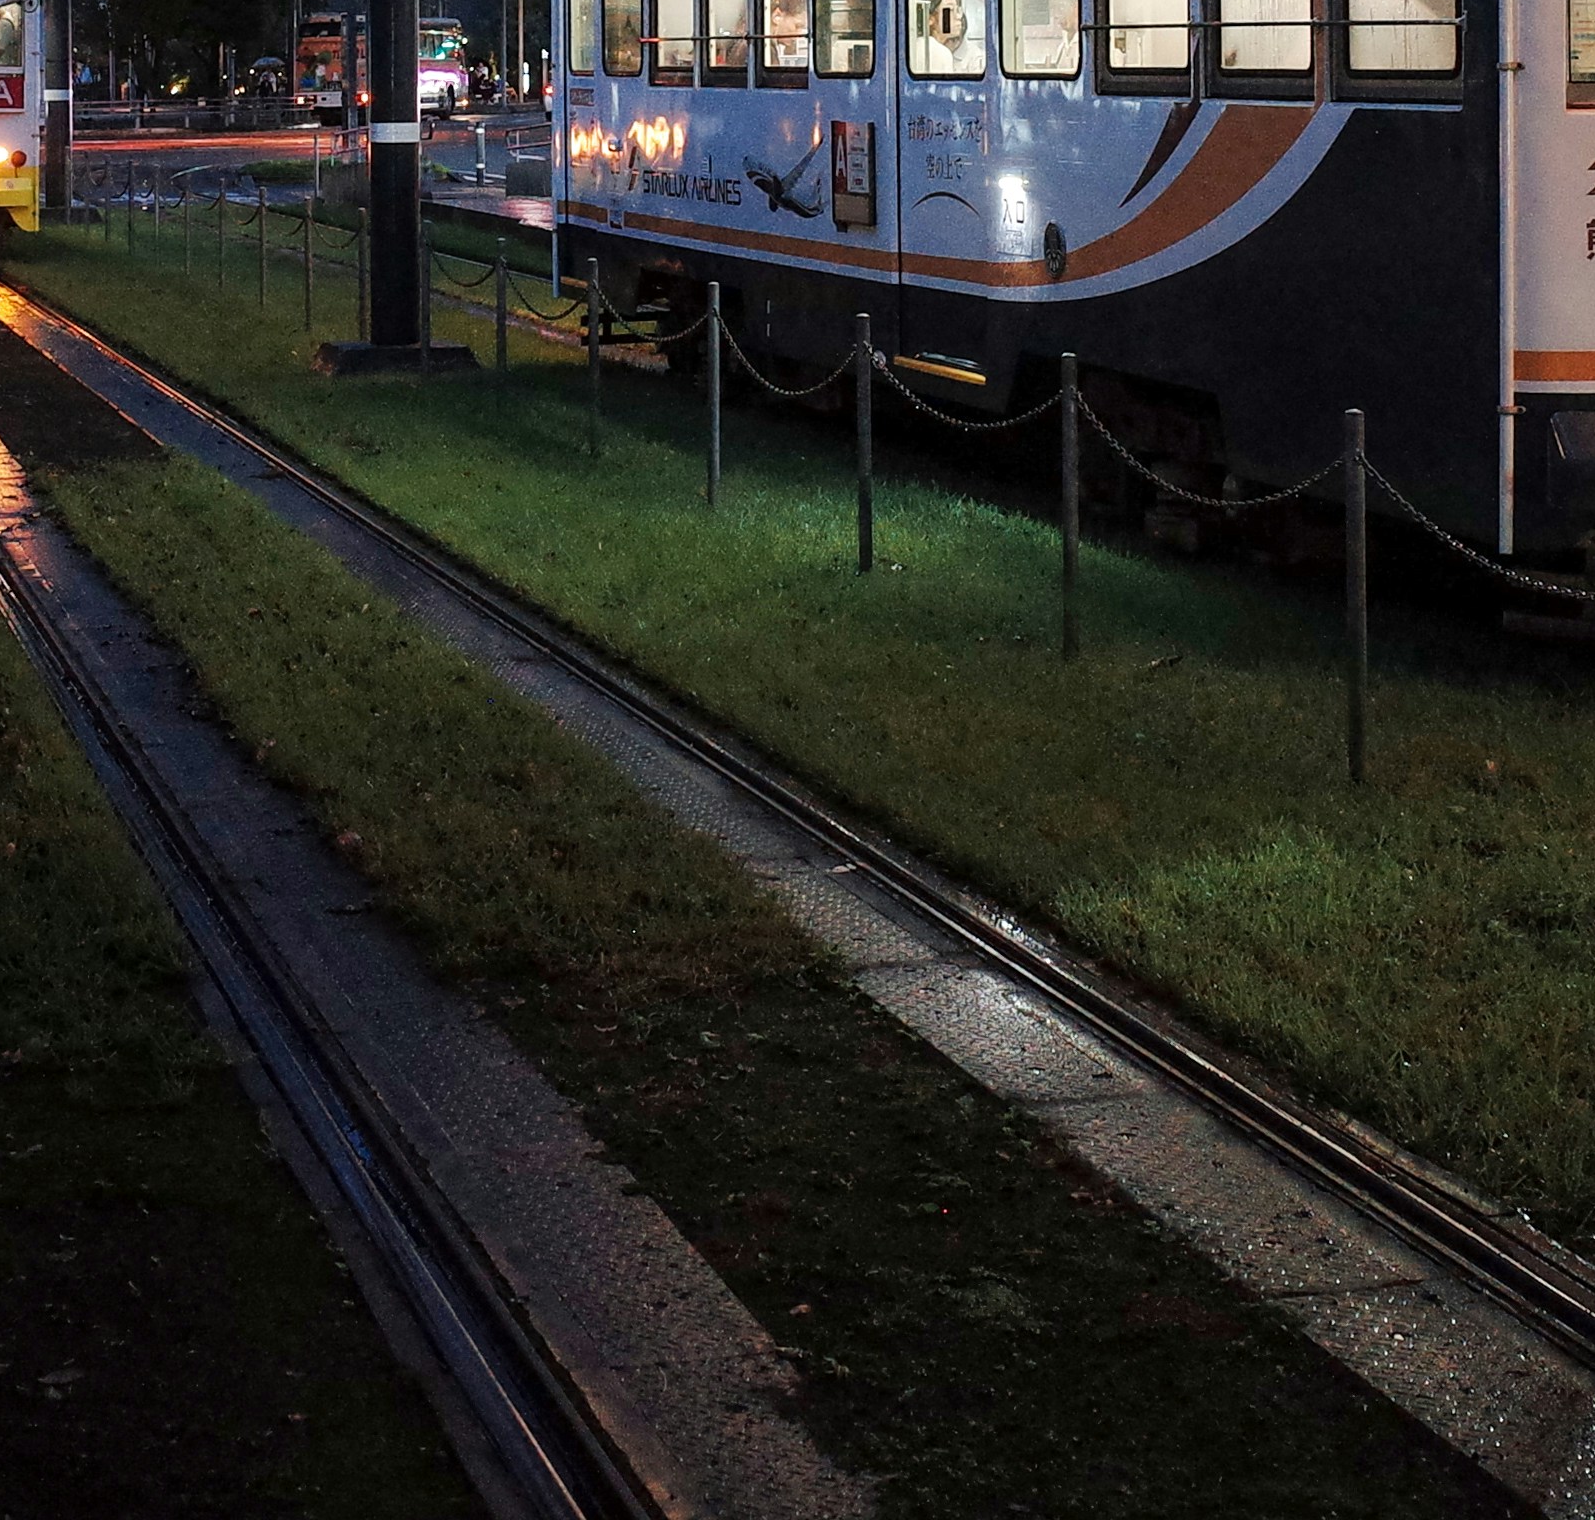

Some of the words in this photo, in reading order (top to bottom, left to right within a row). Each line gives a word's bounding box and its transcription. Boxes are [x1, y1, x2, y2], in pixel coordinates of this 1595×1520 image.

[835, 136, 847, 178] A
[642, 171, 688, 197] STARLUX
[691, 176, 742, 205] AIRLINES
[1003, 199, 1025, 224] 入口
